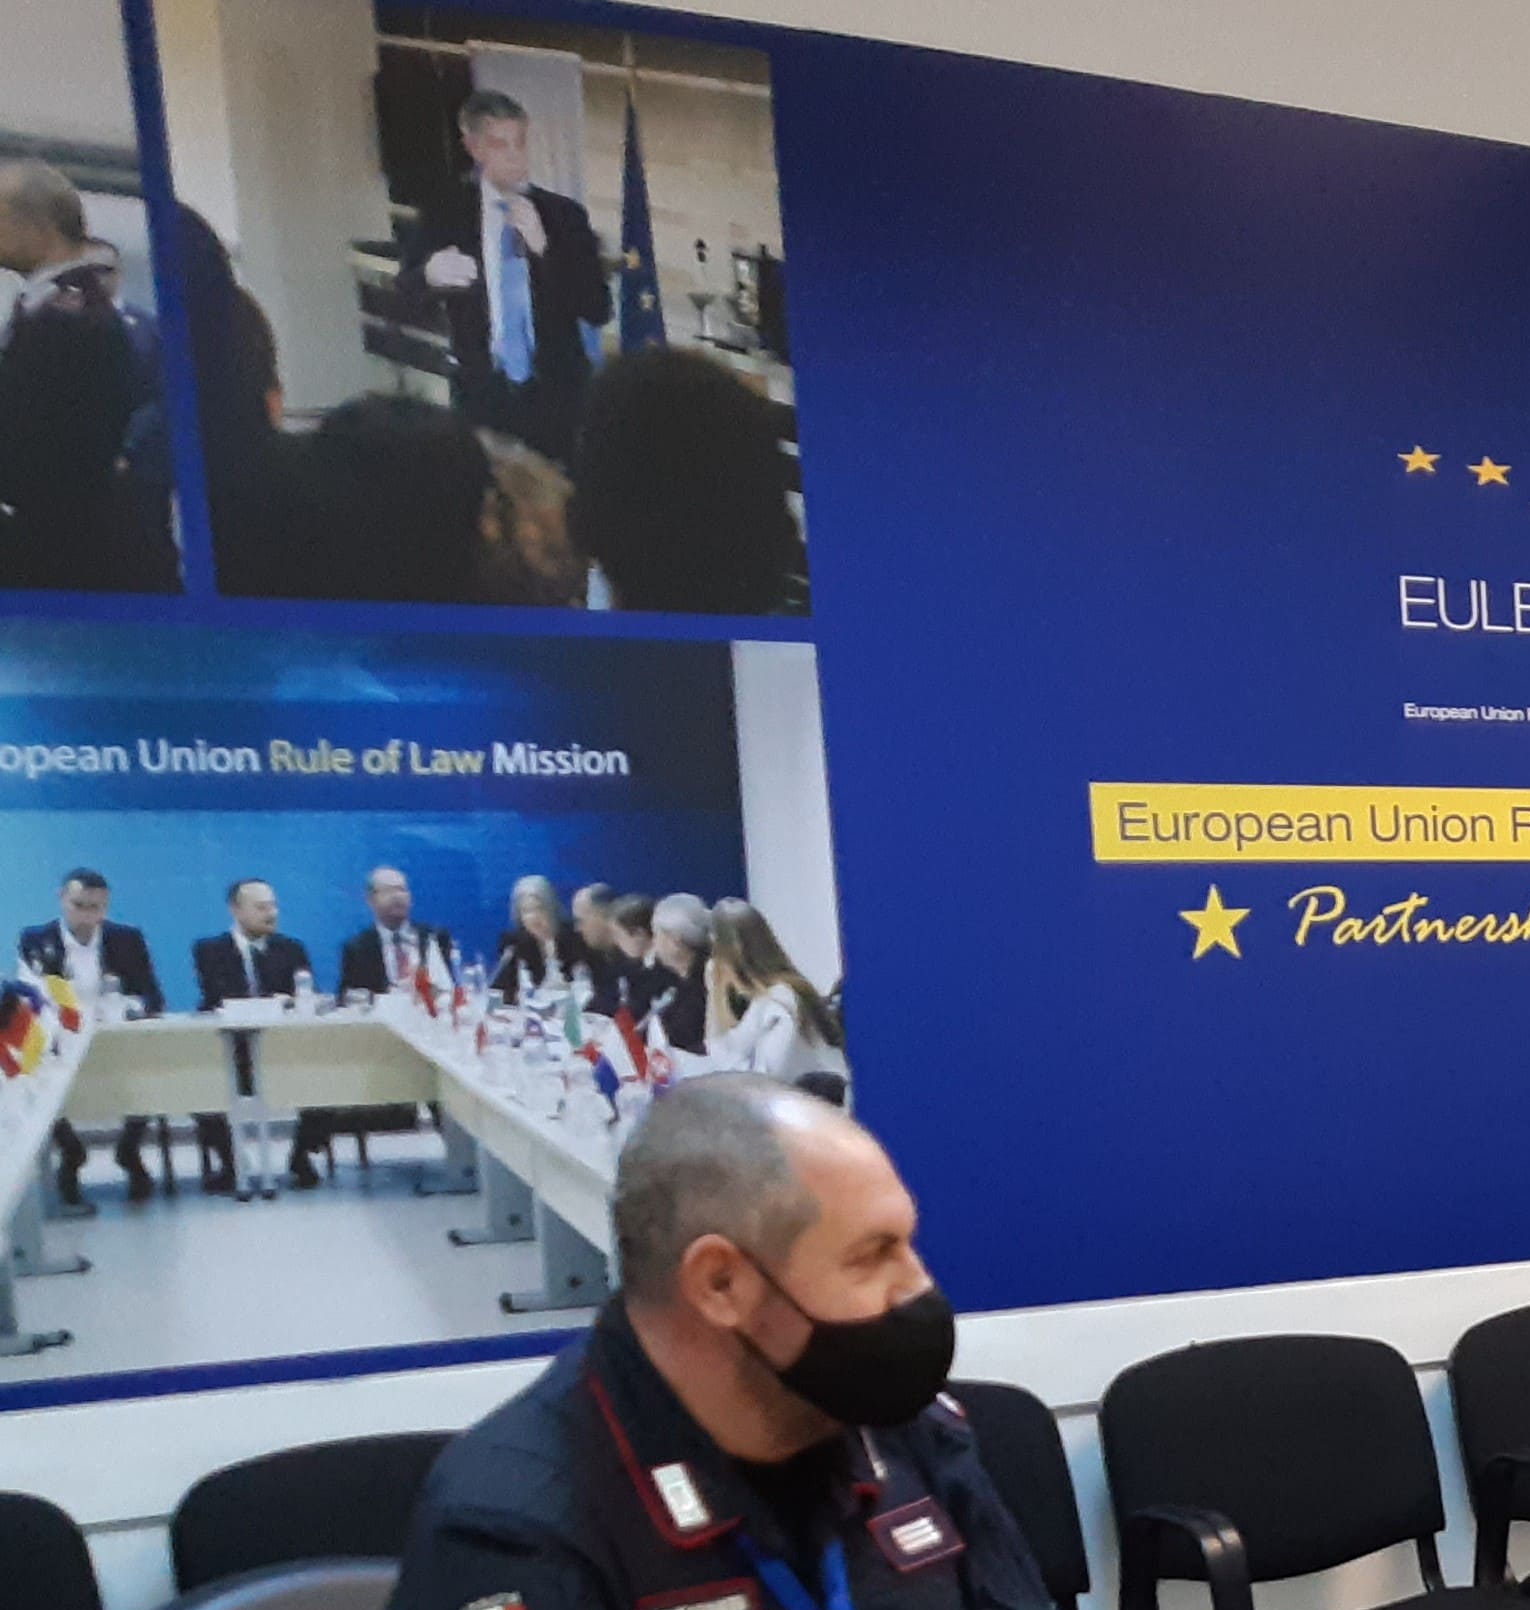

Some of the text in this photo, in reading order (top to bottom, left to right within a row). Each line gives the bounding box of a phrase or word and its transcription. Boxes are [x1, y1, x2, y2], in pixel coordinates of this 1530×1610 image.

[1404, 703, 1478, 721] European
[1480, 706, 1524, 722] Union
[138, 738, 261, 773] Union
[269, 737, 354, 774] Rule
[362, 738, 403, 775] of
[410, 741, 485, 775] Law
[493, 742, 629, 776] Mission
[1117, 802, 1352, 851] European
[1370, 804, 1494, 843] Union
